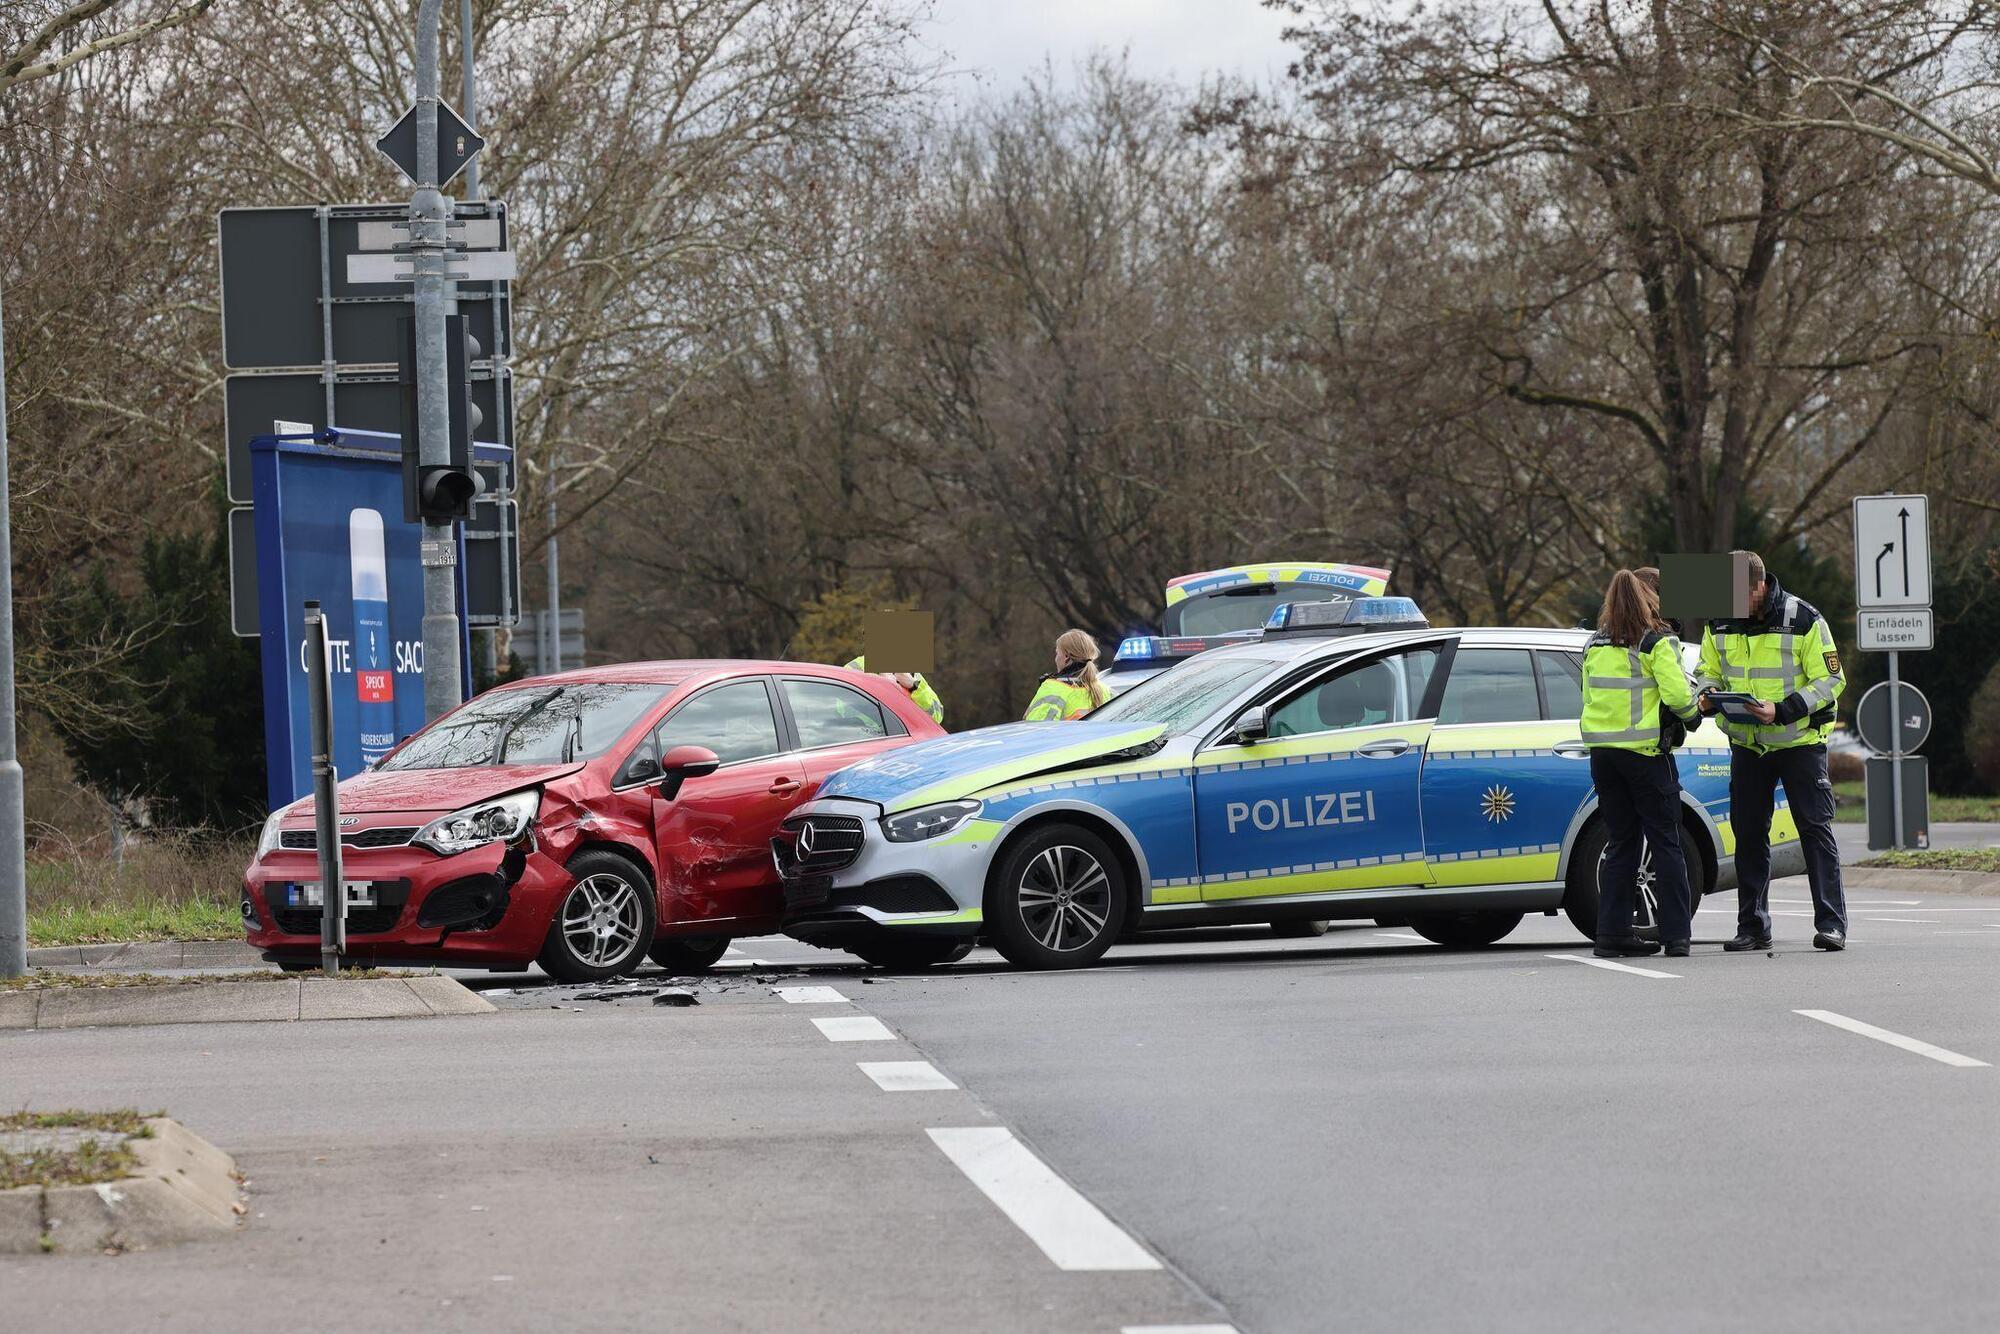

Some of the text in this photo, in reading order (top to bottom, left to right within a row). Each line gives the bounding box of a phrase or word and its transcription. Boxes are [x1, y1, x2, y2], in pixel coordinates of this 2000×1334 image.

[1308, 573, 1355, 585] POLIZEI
[1868, 616, 1923, 628] Einfädeln
[1876, 632, 1915, 641] lassen
[396, 641, 424, 673] SAC
[365, 675, 385, 689] SPEICK
[1226, 790, 1376, 833] POLIZEI
